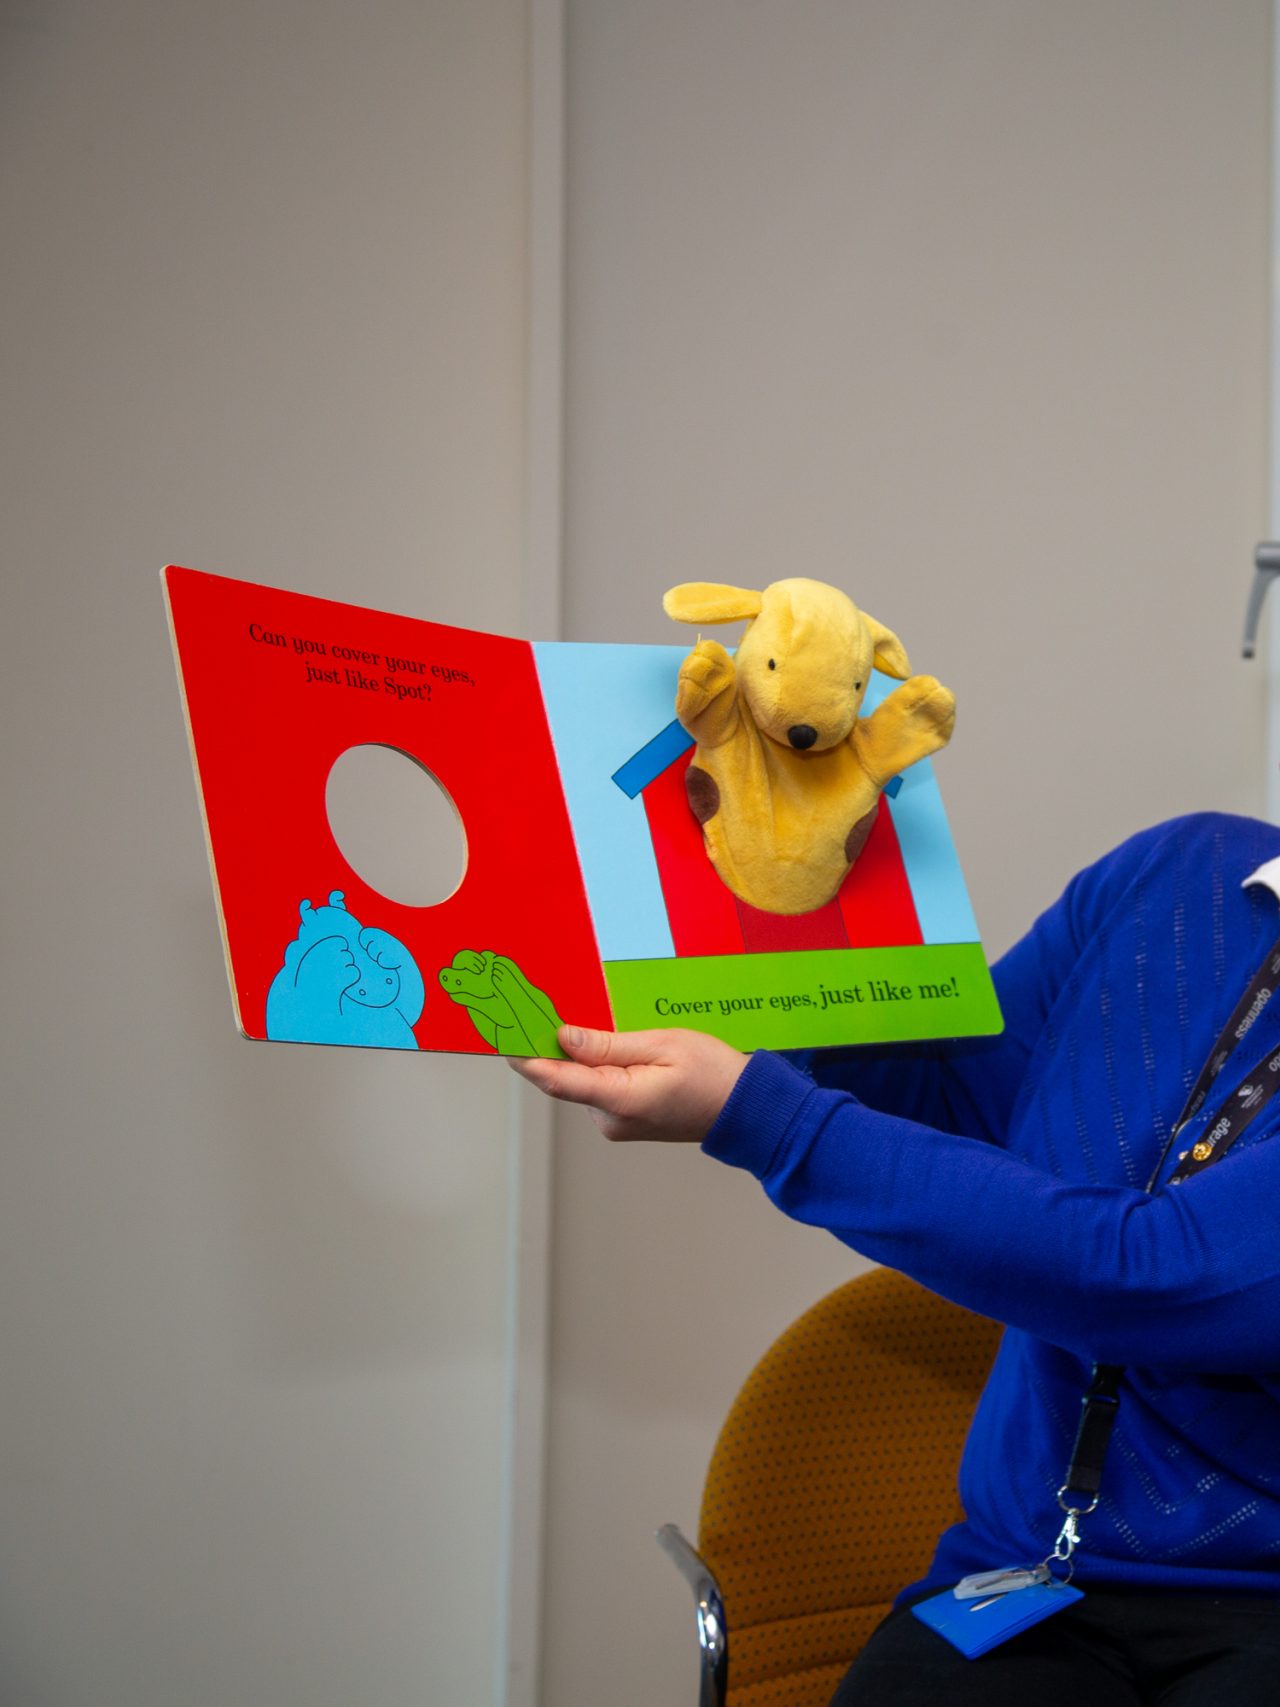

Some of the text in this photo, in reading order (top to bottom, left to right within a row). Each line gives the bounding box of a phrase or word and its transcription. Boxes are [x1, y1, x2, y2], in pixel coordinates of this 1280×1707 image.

[249, 623, 475, 686] Can you cover your eyes,
[305, 661, 431, 700] just like Spot?
[655, 976, 961, 1016] Cover your eyes, just like me!
[1235, 987, 1271, 1040] openness
